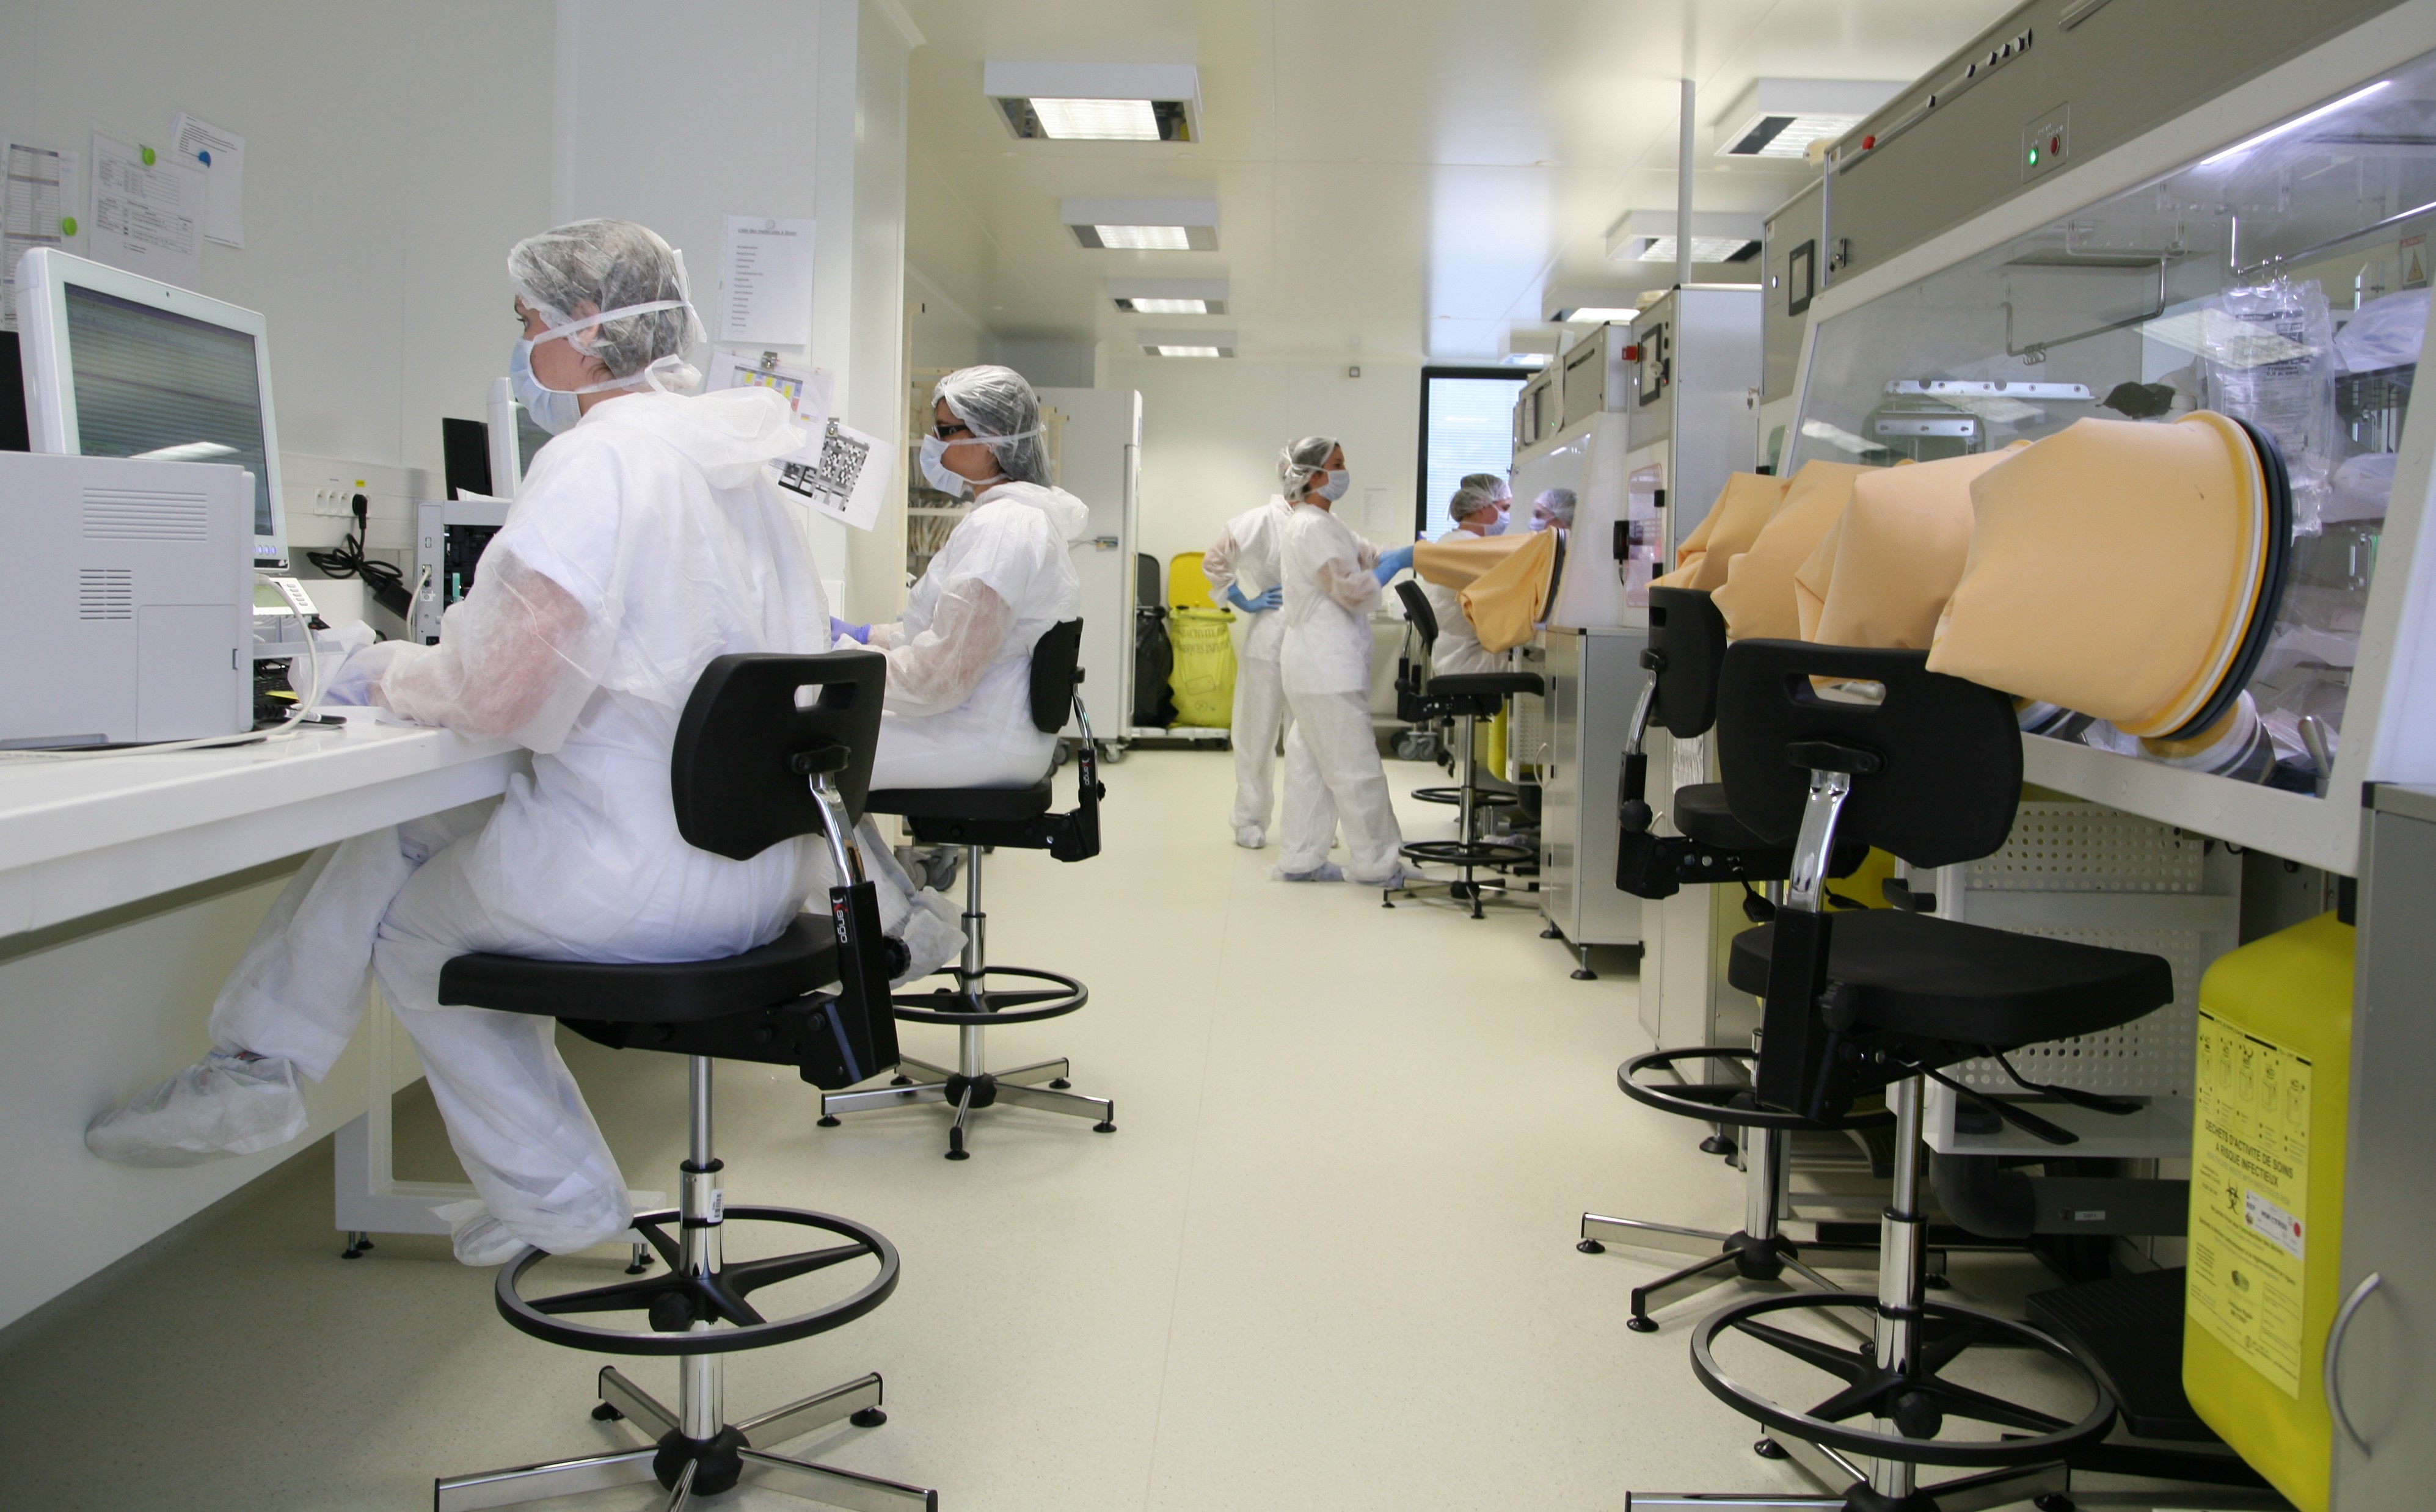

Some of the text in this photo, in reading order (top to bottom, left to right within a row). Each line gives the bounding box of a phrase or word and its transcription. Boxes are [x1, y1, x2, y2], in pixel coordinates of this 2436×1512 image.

[833, 895, 849, 943] Kango
[2220, 1144, 2241, 1166] RISQUE
[2241, 1158, 2278, 1187] INFECTIEUX
[2262, 1153, 2271, 1168] DE
[2273, 1158, 2294, 1179] SOINS
